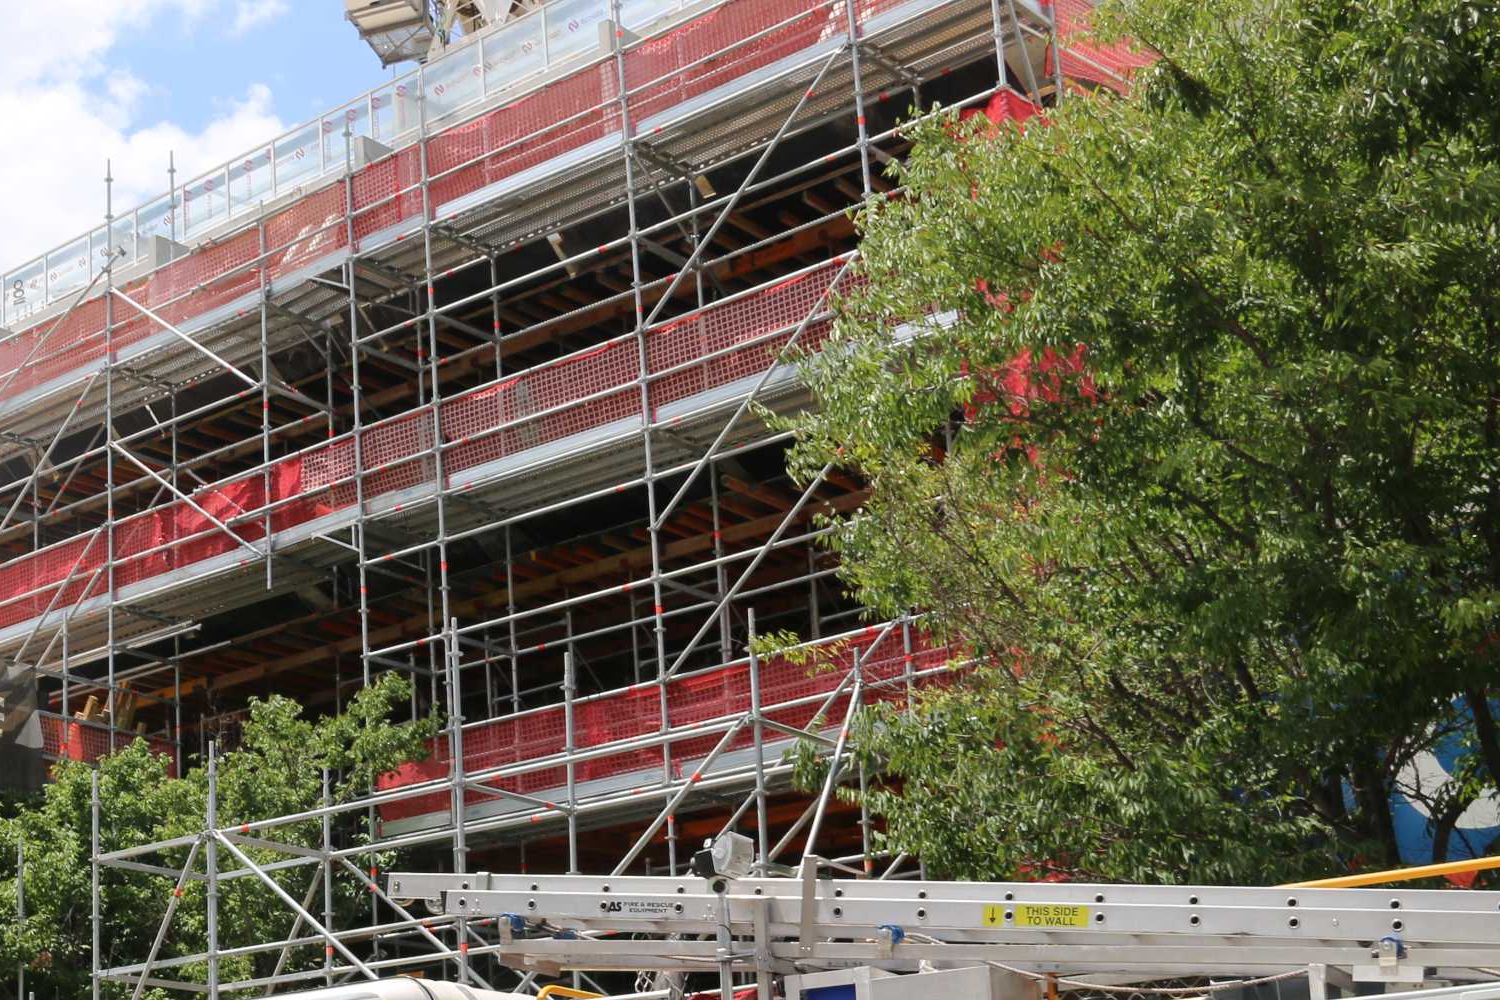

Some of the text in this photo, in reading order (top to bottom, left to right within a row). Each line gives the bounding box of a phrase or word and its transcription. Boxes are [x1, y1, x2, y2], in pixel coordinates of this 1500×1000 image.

[1026, 906, 1079, 916] THIS SIDE
[1028, 916, 1076, 926] TO WALL
